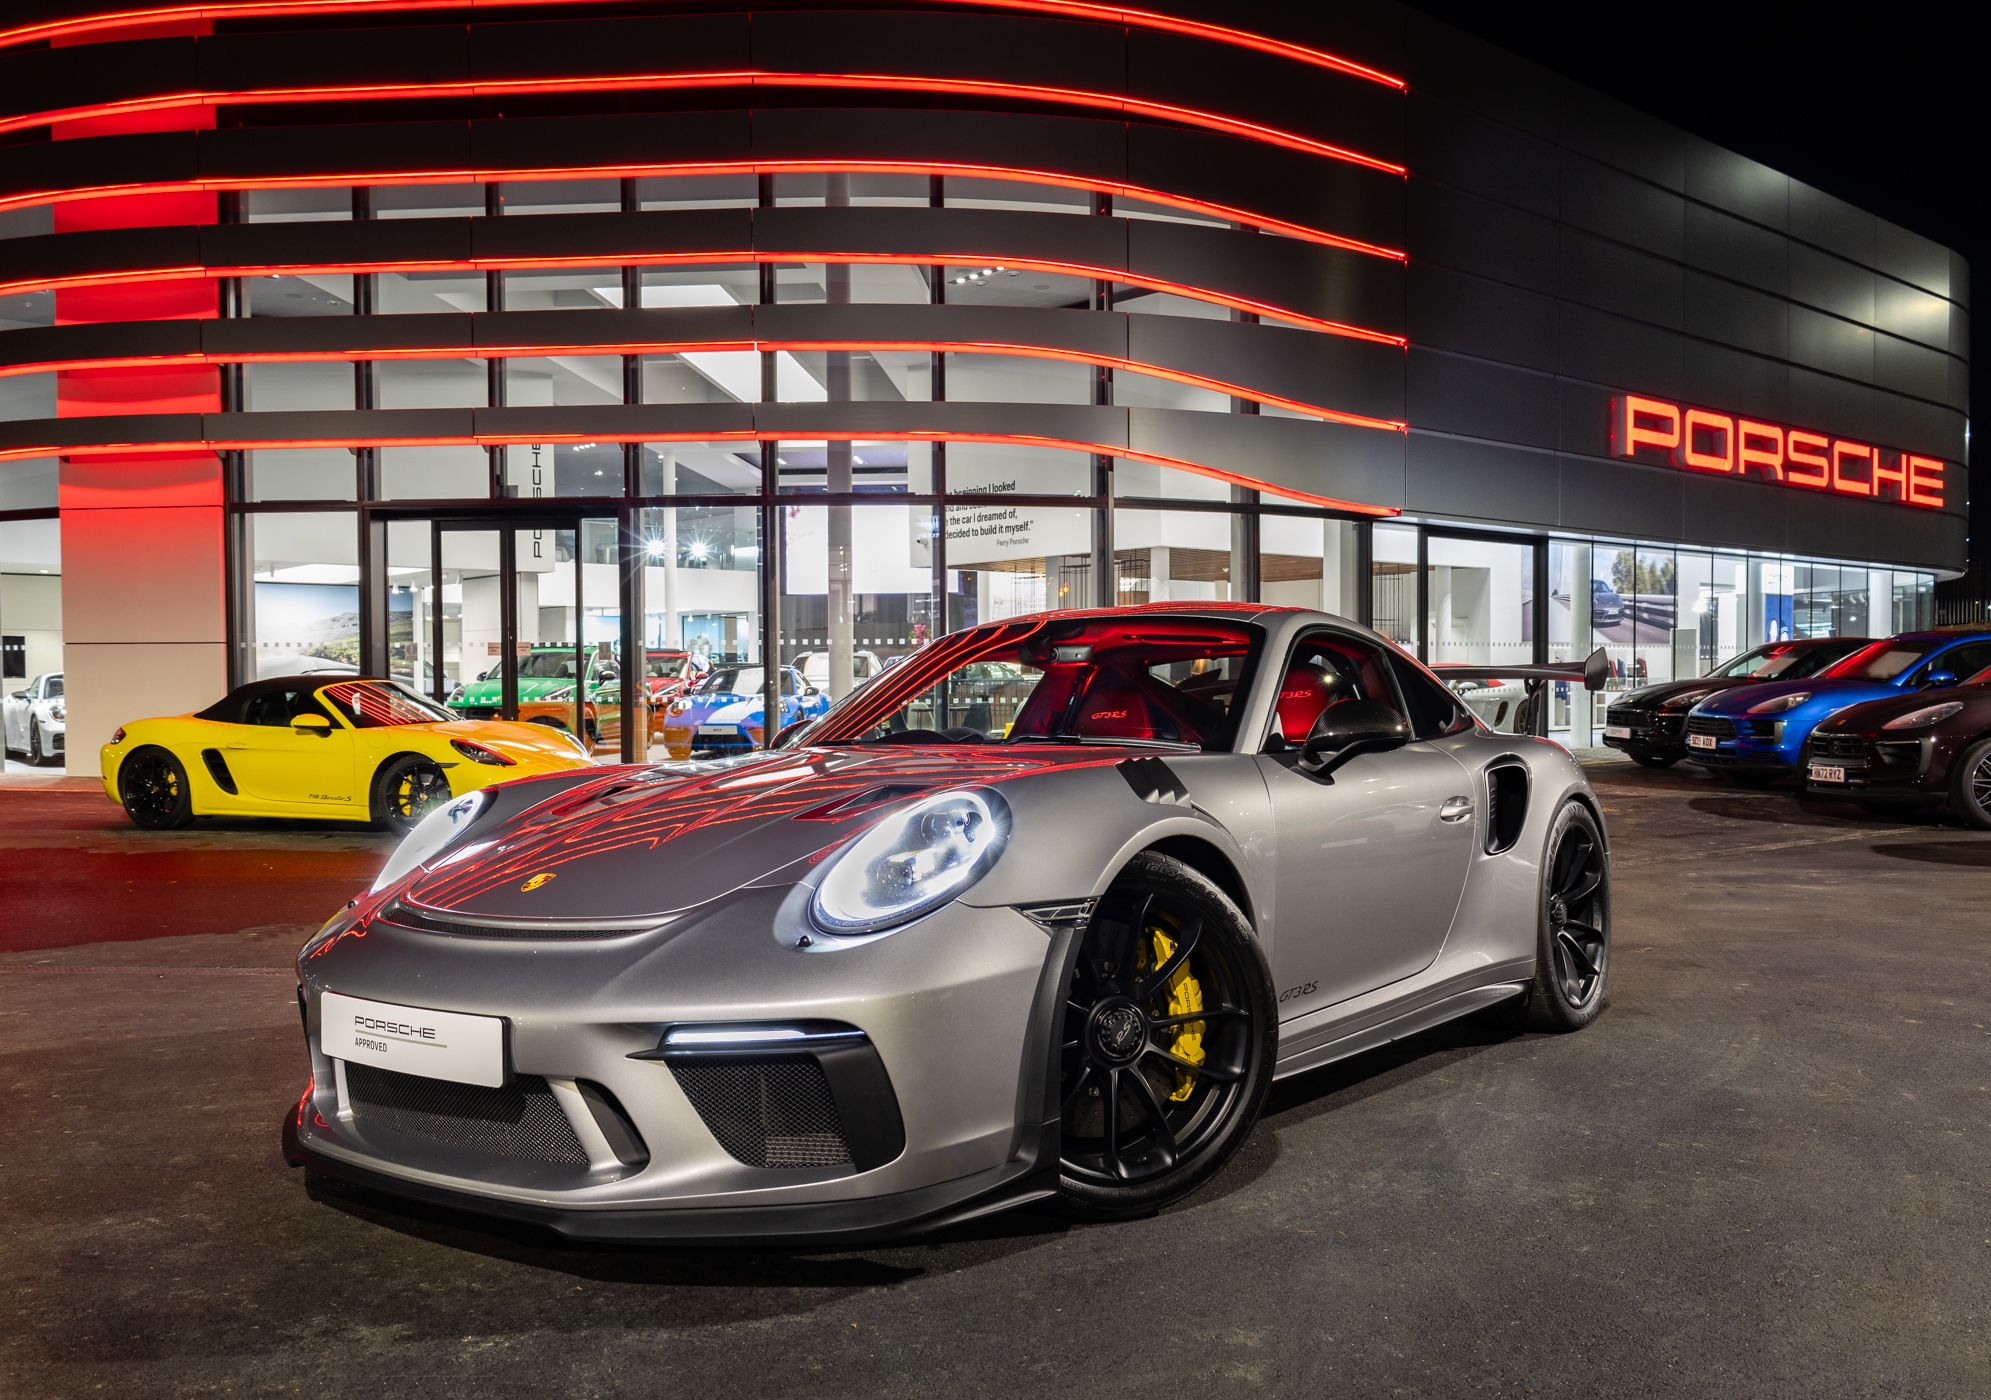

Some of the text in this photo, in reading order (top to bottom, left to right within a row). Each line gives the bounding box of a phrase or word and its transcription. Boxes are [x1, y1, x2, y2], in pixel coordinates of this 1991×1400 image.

[1626, 395, 1944, 508] PORSCHE
[992, 480, 1016, 493] looked
[532, 444, 542, 558] POSCH
[949, 516, 961, 526] the
[961, 516, 972, 524] car
[977, 509, 1007, 523] dreamed
[1008, 507, 1018, 519] of,
[971, 529, 979, 537] to
[980, 524, 997, 536] build
[998, 524, 1004, 534] it
[996, 537, 1029, 548] Ferry Porsche
[1280, 689, 1312, 700] T3RS
[354, 1015, 436, 1040] PORSCHE
[354, 1037, 388, 1053] APPROVED
